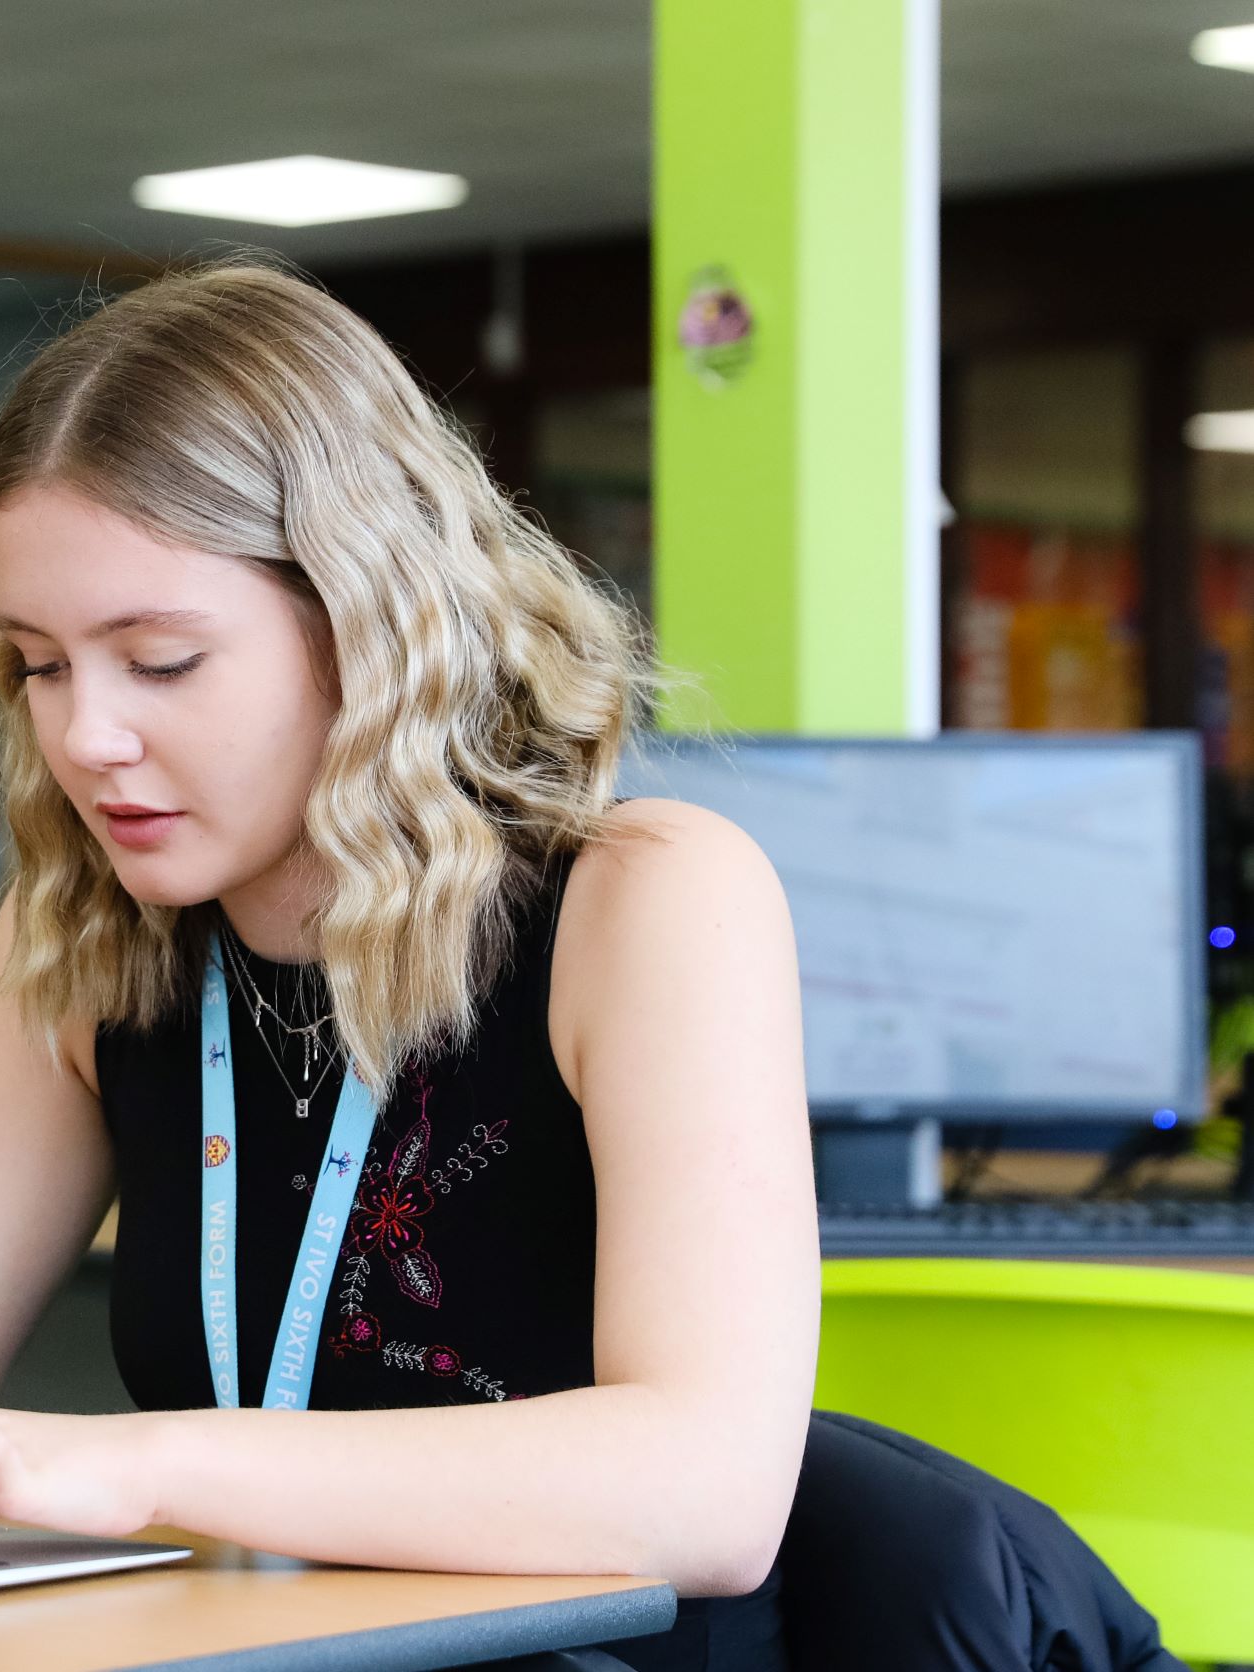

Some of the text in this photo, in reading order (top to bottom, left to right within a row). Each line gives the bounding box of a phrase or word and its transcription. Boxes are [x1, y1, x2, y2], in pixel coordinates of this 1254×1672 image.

[209, 1200, 227, 1280] FORM
[313, 1212, 337, 1243] ST
[300, 1247, 327, 1301] IVO
[209, 1290, 229, 1363] SIXTH
[280, 1306, 313, 1381] SIXTH
